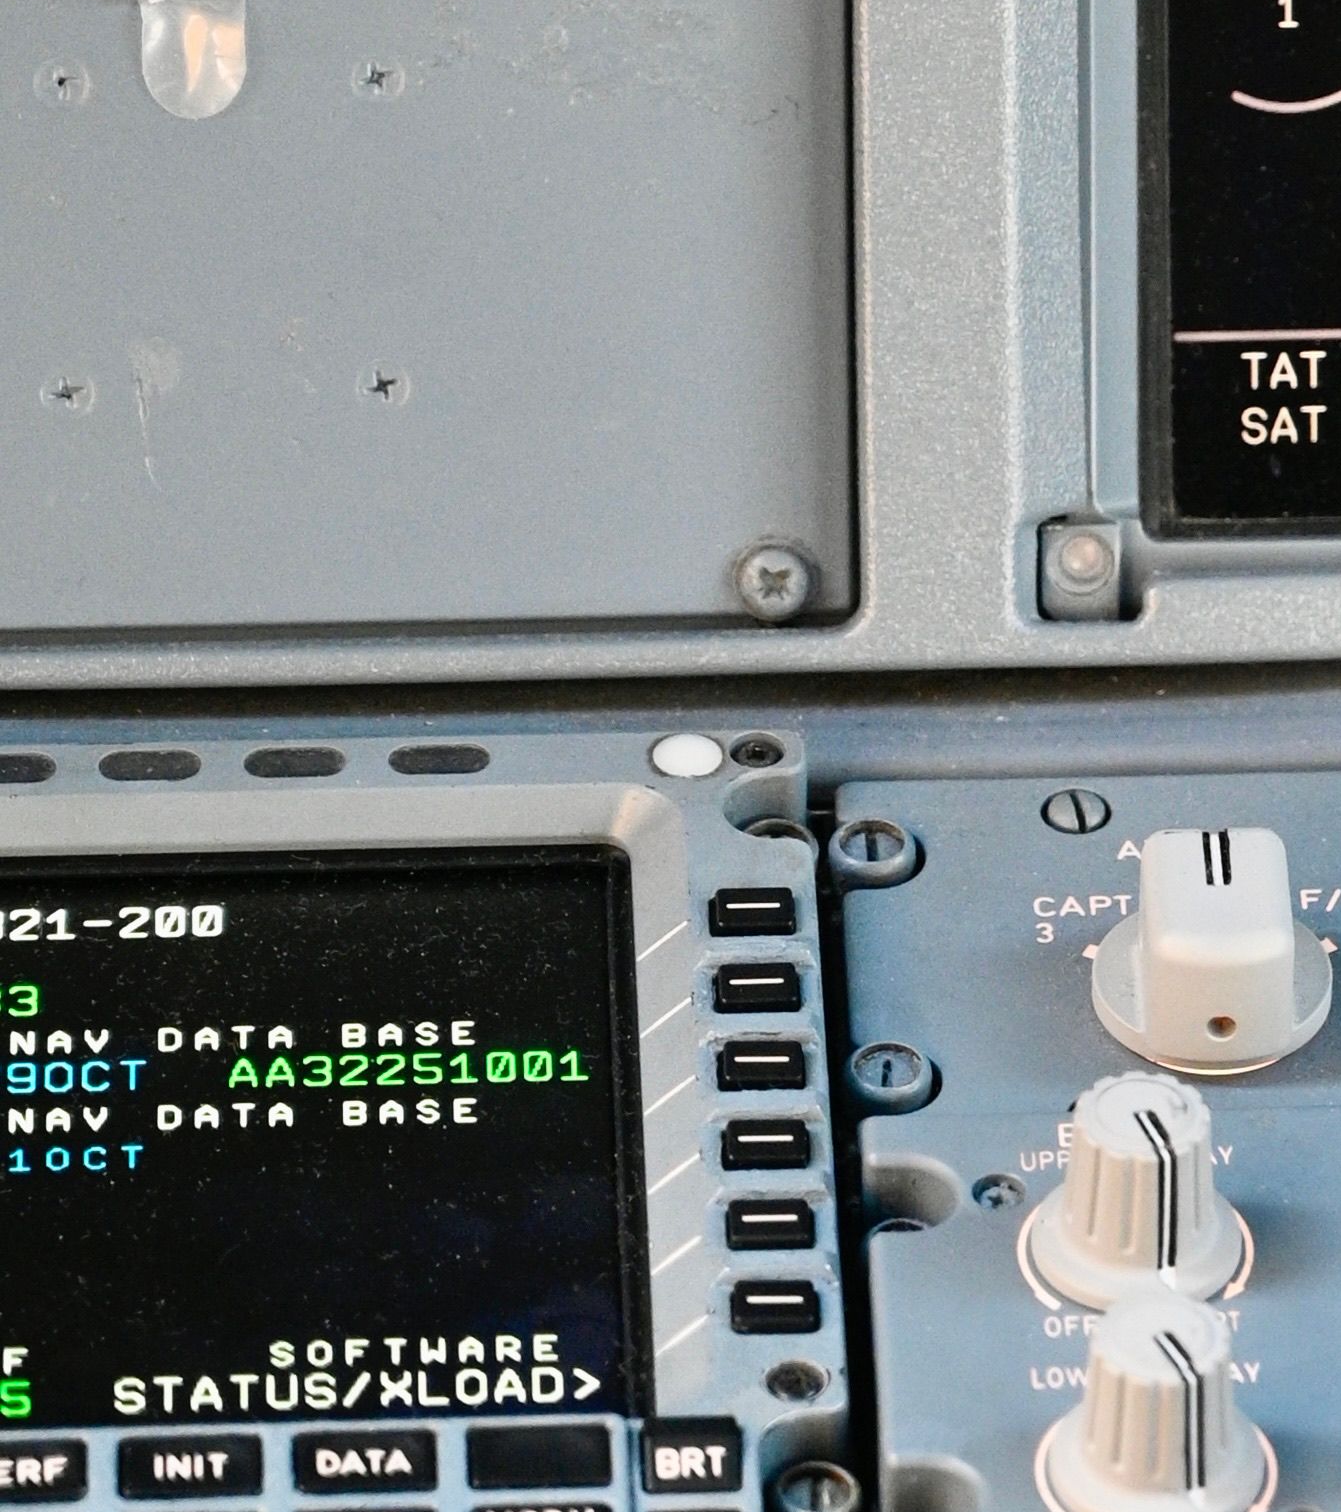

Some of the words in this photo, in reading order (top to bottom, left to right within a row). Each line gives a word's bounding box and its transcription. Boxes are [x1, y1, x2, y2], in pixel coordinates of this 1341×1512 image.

[1240, 350, 1327, 390] TAT
[1240, 404, 1327, 446] SAT
[1032, 894, 1132, 918] CAPT
[9, 1028, 110, 1056] NAV
[157, 1025, 293, 1053] DATA
[341, 1020, 476, 1049] BASE
[269, 1333, 559, 1369] SOFTWARE
[654, 1445, 726, 1480] BRT
